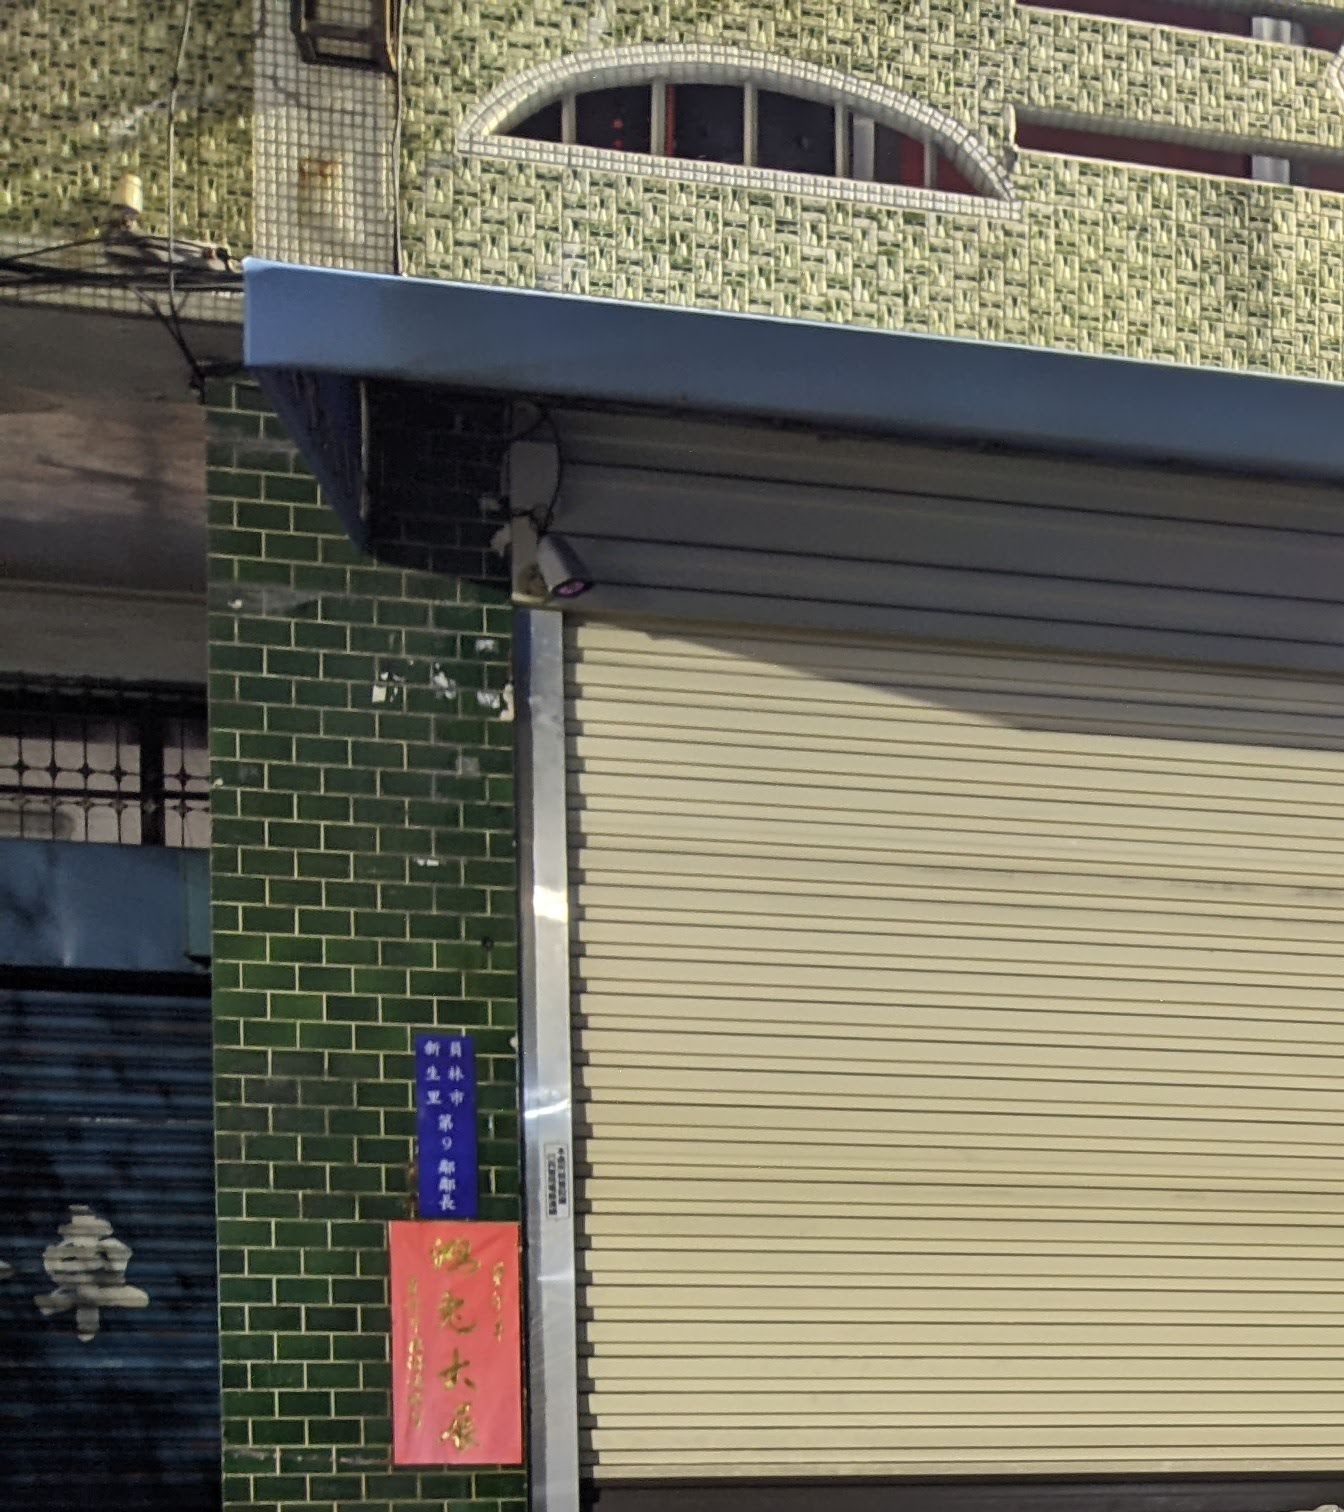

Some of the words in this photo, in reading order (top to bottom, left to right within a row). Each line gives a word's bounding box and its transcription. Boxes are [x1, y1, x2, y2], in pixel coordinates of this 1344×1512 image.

[424, 1039, 442, 1105] 新生里
[448, 1040, 465, 1107] 員林市
